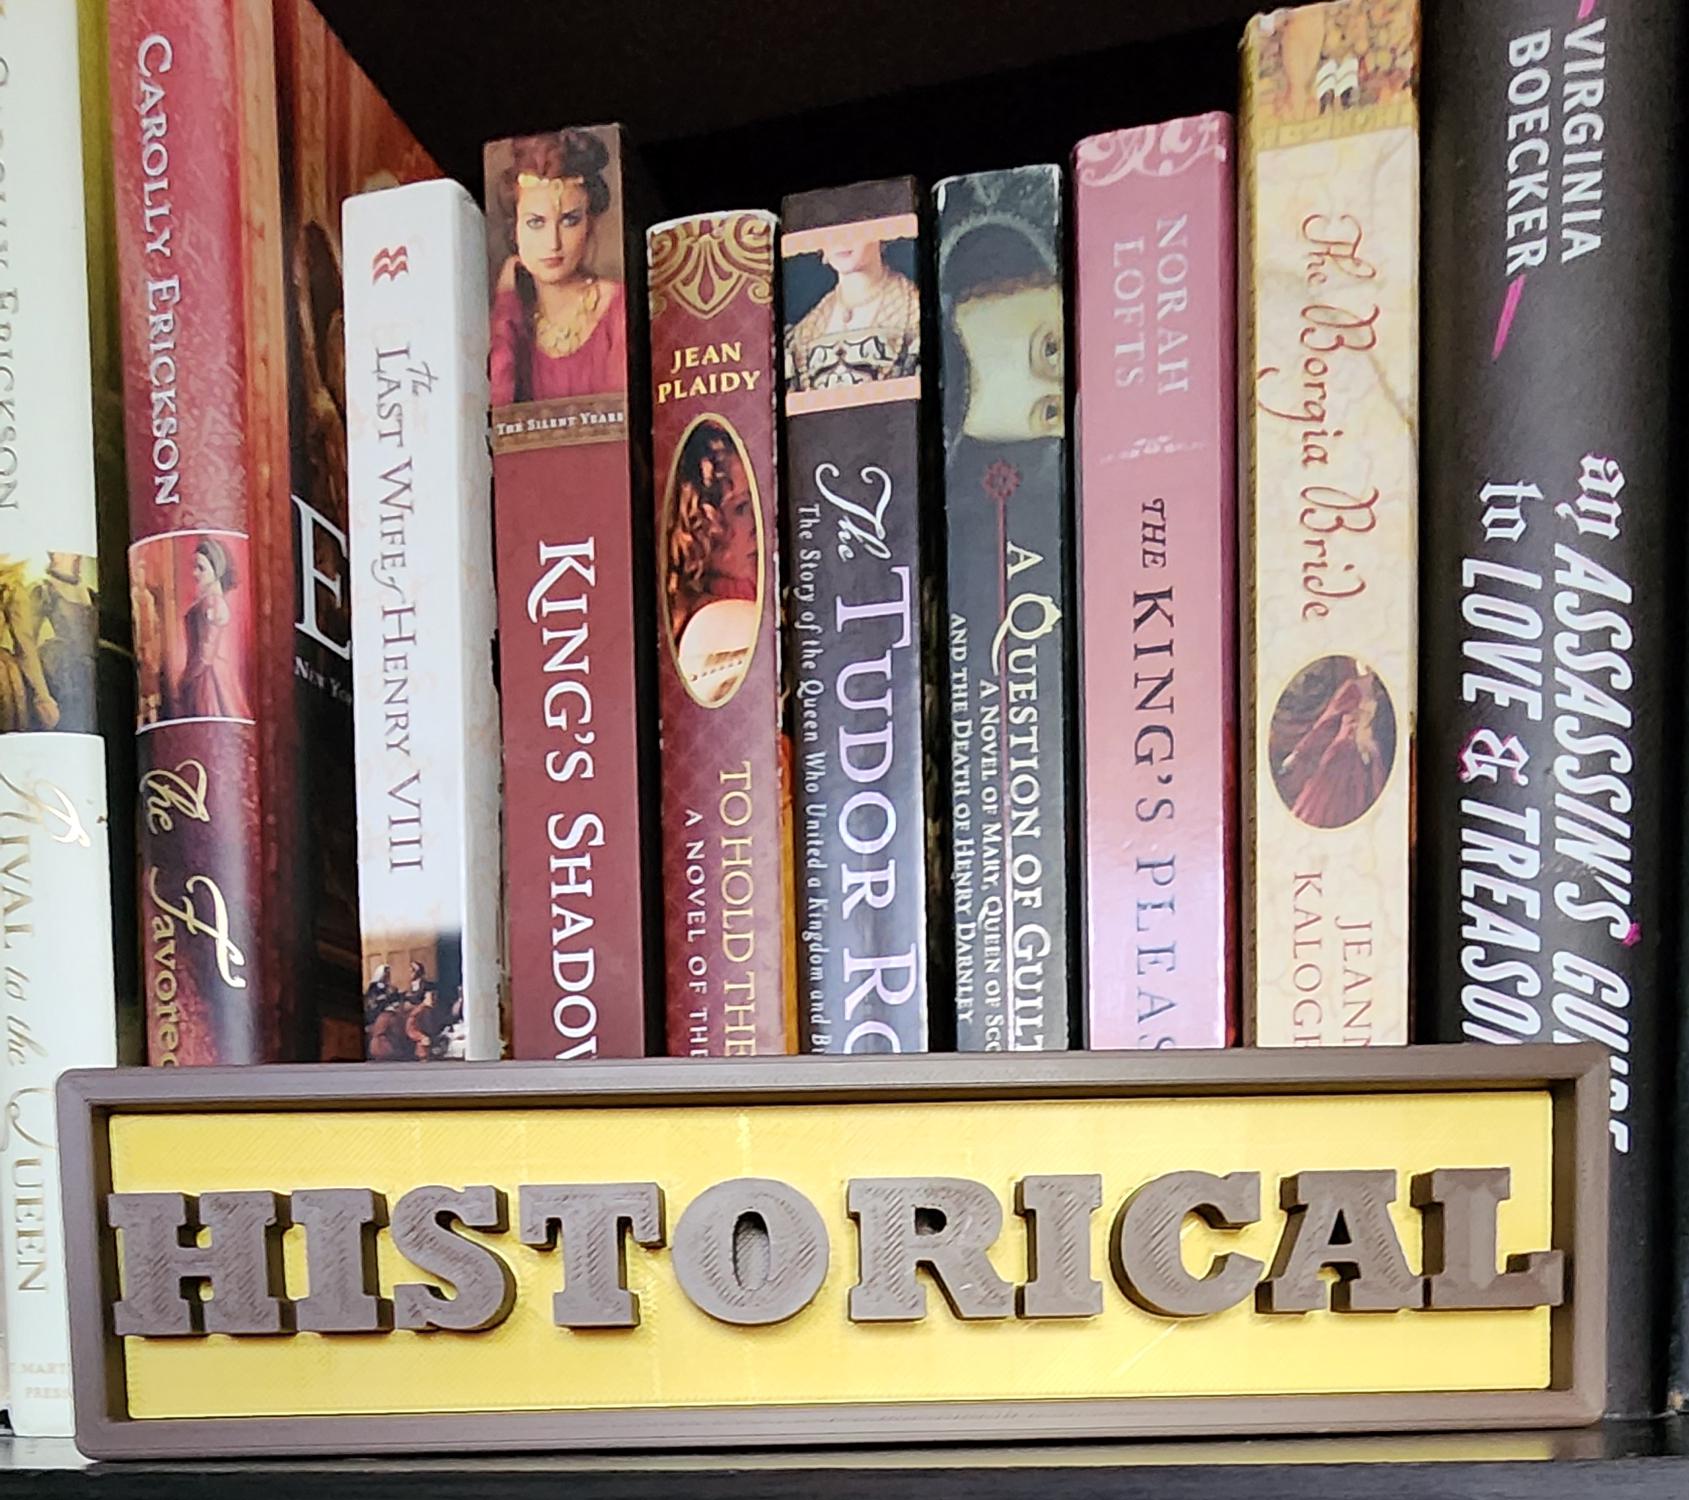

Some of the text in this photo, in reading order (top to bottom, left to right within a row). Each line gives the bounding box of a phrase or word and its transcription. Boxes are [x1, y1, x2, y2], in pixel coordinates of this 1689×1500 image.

[1504, 27, 1552, 277] BOECKER
[1560, 17, 1607, 265] VIRGINIA
[137, 33, 182, 506] CAROLLY ERICKSON
[1156, 213, 1190, 396] NORAH
[1113, 236, 1146, 388] LOFTS
[373, 341, 411, 448] LAST
[657, 369, 762, 404] PLAIDY
[670, 340, 742, 375] JEAN
[1256, 212, 1381, 624] The Borgia Bride
[378, 455, 415, 571] WIFE
[797, 504, 821, 540] The
[815, 462, 893, 562] The
[1141, 497, 1169, 570] THE
[1479, 478, 1545, 543] to
[792, 549, 822, 602] Story
[1006, 541, 1045, 580] A
[526, 536, 597, 782] KING'S
[794, 611, 823, 634] of
[799, 635, 825, 670] the
[1460, 557, 1544, 723] LOVE
[381, 601, 418, 757] HENRY
[796, 679, 825, 743] Queen
[979, 679, 1000, 699] A
[991, 592, 1063, 839] QUESTION
[1132, 585, 1176, 824] KING'S
[804, 750, 827, 793] Who
[835, 566, 912, 920] TUDOR
[979, 704, 1001, 781] NOVEL
[1552, 542, 1634, 944] ASSASSIN'S
[386, 771, 424, 873] VIII
[685, 808, 705, 827] A
[805, 802, 828, 868] United
[950, 613, 977, 1025] AND THE DEATH OF HENRY DARNLEY
[981, 787, 998, 816] OF
[685, 842, 707, 943] NOVEL
[806, 876, 822, 888] a
[981, 822, 1003, 891] MARY,
[1011, 853, 1043, 909] OF
[718, 761, 756, 1057] TO HOLD THE
[801, 896, 830, 981] Kingdom
[977, 896, 1003, 974] QUEEN
[686, 957, 708, 996] OF
[809, 992, 833, 1025] and
[984, 979, 1003, 1008] OF
[107, 1167, 1564, 1340] HISTORICAL
